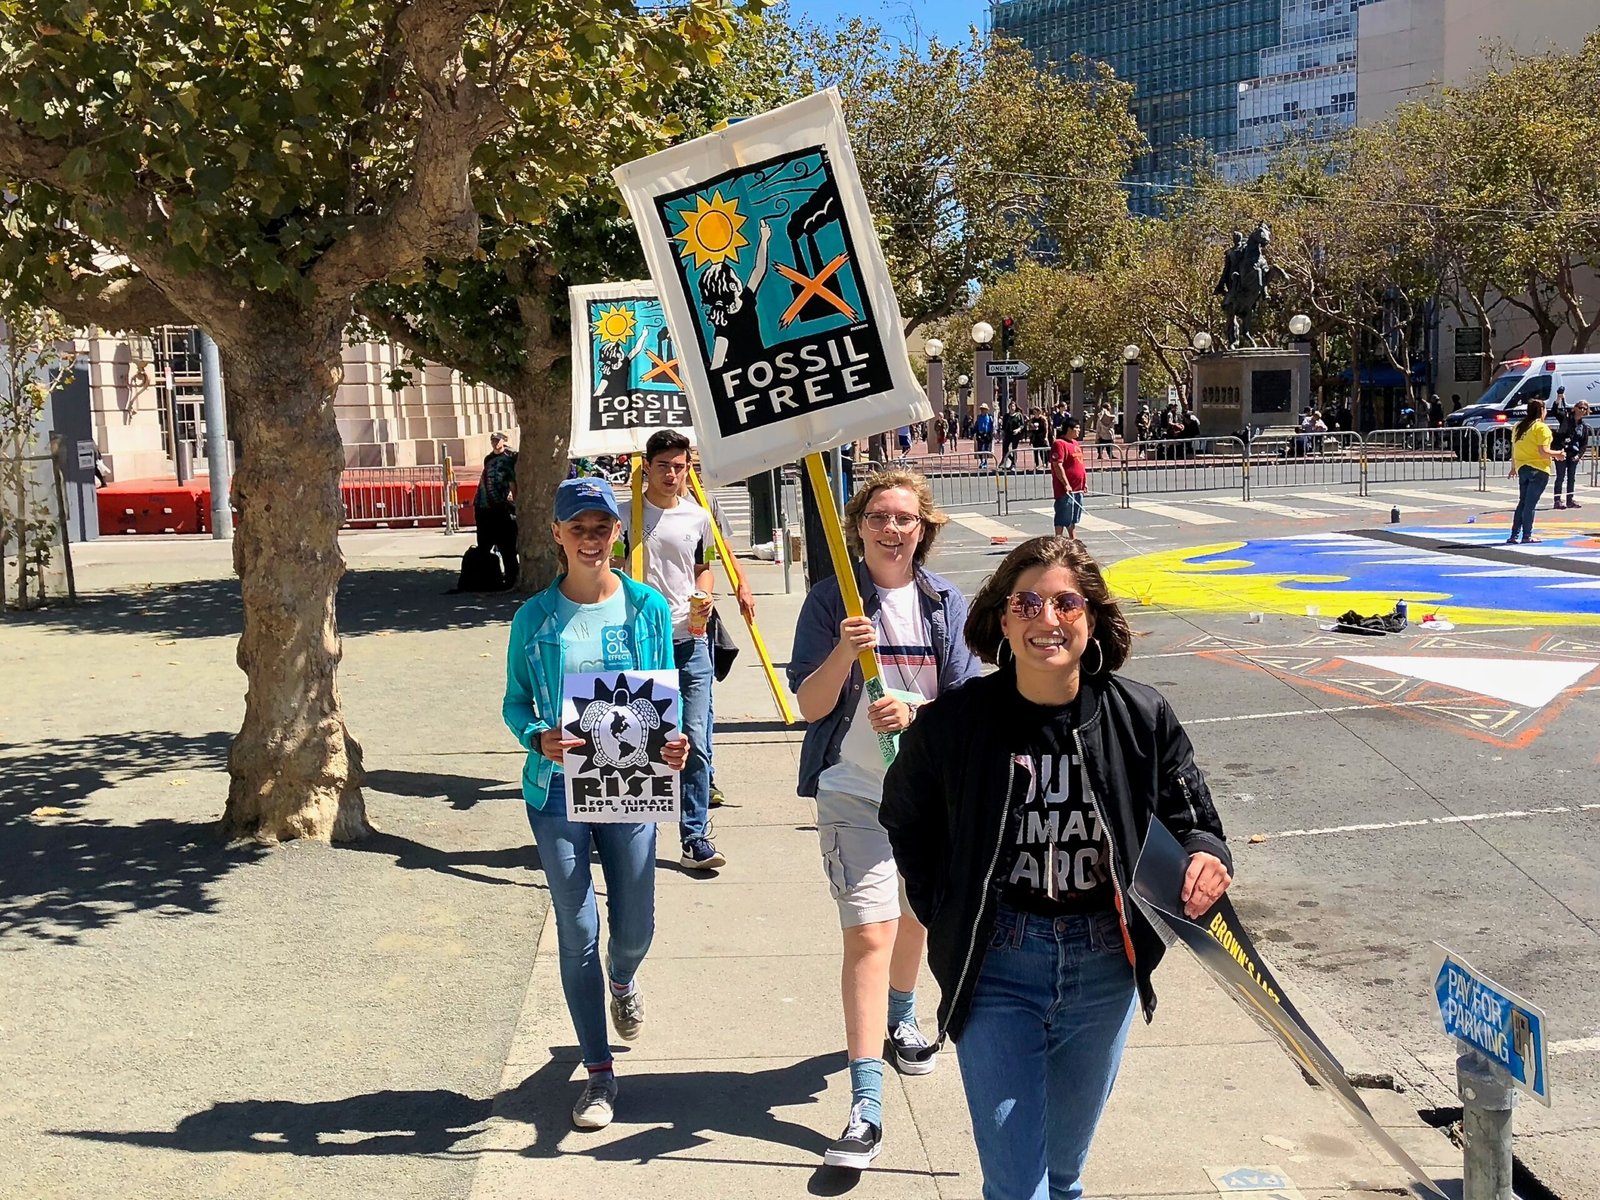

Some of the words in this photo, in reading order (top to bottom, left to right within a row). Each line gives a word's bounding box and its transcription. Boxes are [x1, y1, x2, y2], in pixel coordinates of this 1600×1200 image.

[722, 335, 870, 398] FOSSIL
[734, 363, 871, 425] FREE
[598, 392, 686, 412] FOSSIL
[601, 410, 683, 426] FREE
[571, 775, 673, 805] RISE
[574, 806, 604, 814] JOBS
[624, 805, 674, 814] JUSTICE
[1209, 912, 1255, 979] BROWN'S
[1448, 968, 1472, 1007] PAY
[1472, 985, 1502, 1030] FOR
[1448, 997, 1510, 1064] PARKING
